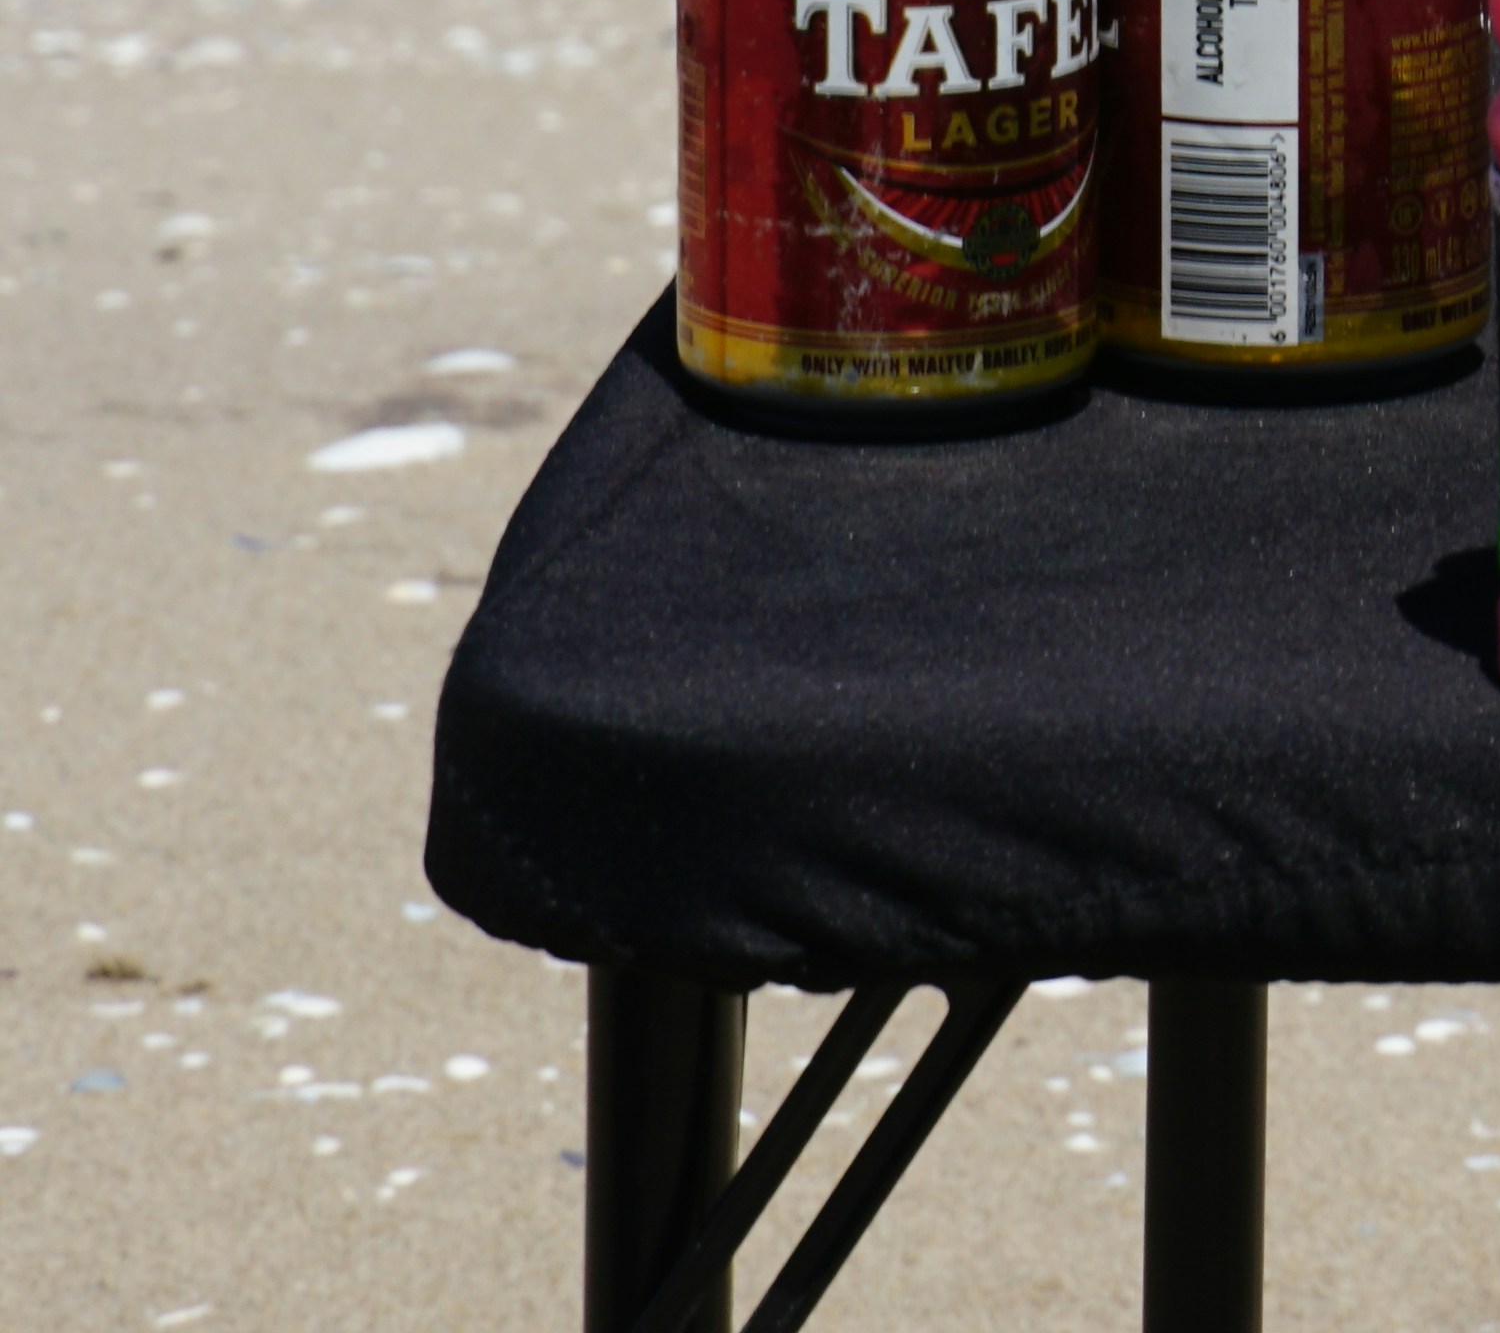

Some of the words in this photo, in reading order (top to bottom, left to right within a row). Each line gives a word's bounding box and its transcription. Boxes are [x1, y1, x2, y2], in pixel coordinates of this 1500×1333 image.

[902, 90, 1079, 152] LAGER
[802, 354, 845, 376] ONLY
[851, 352, 900, 378] WITH
